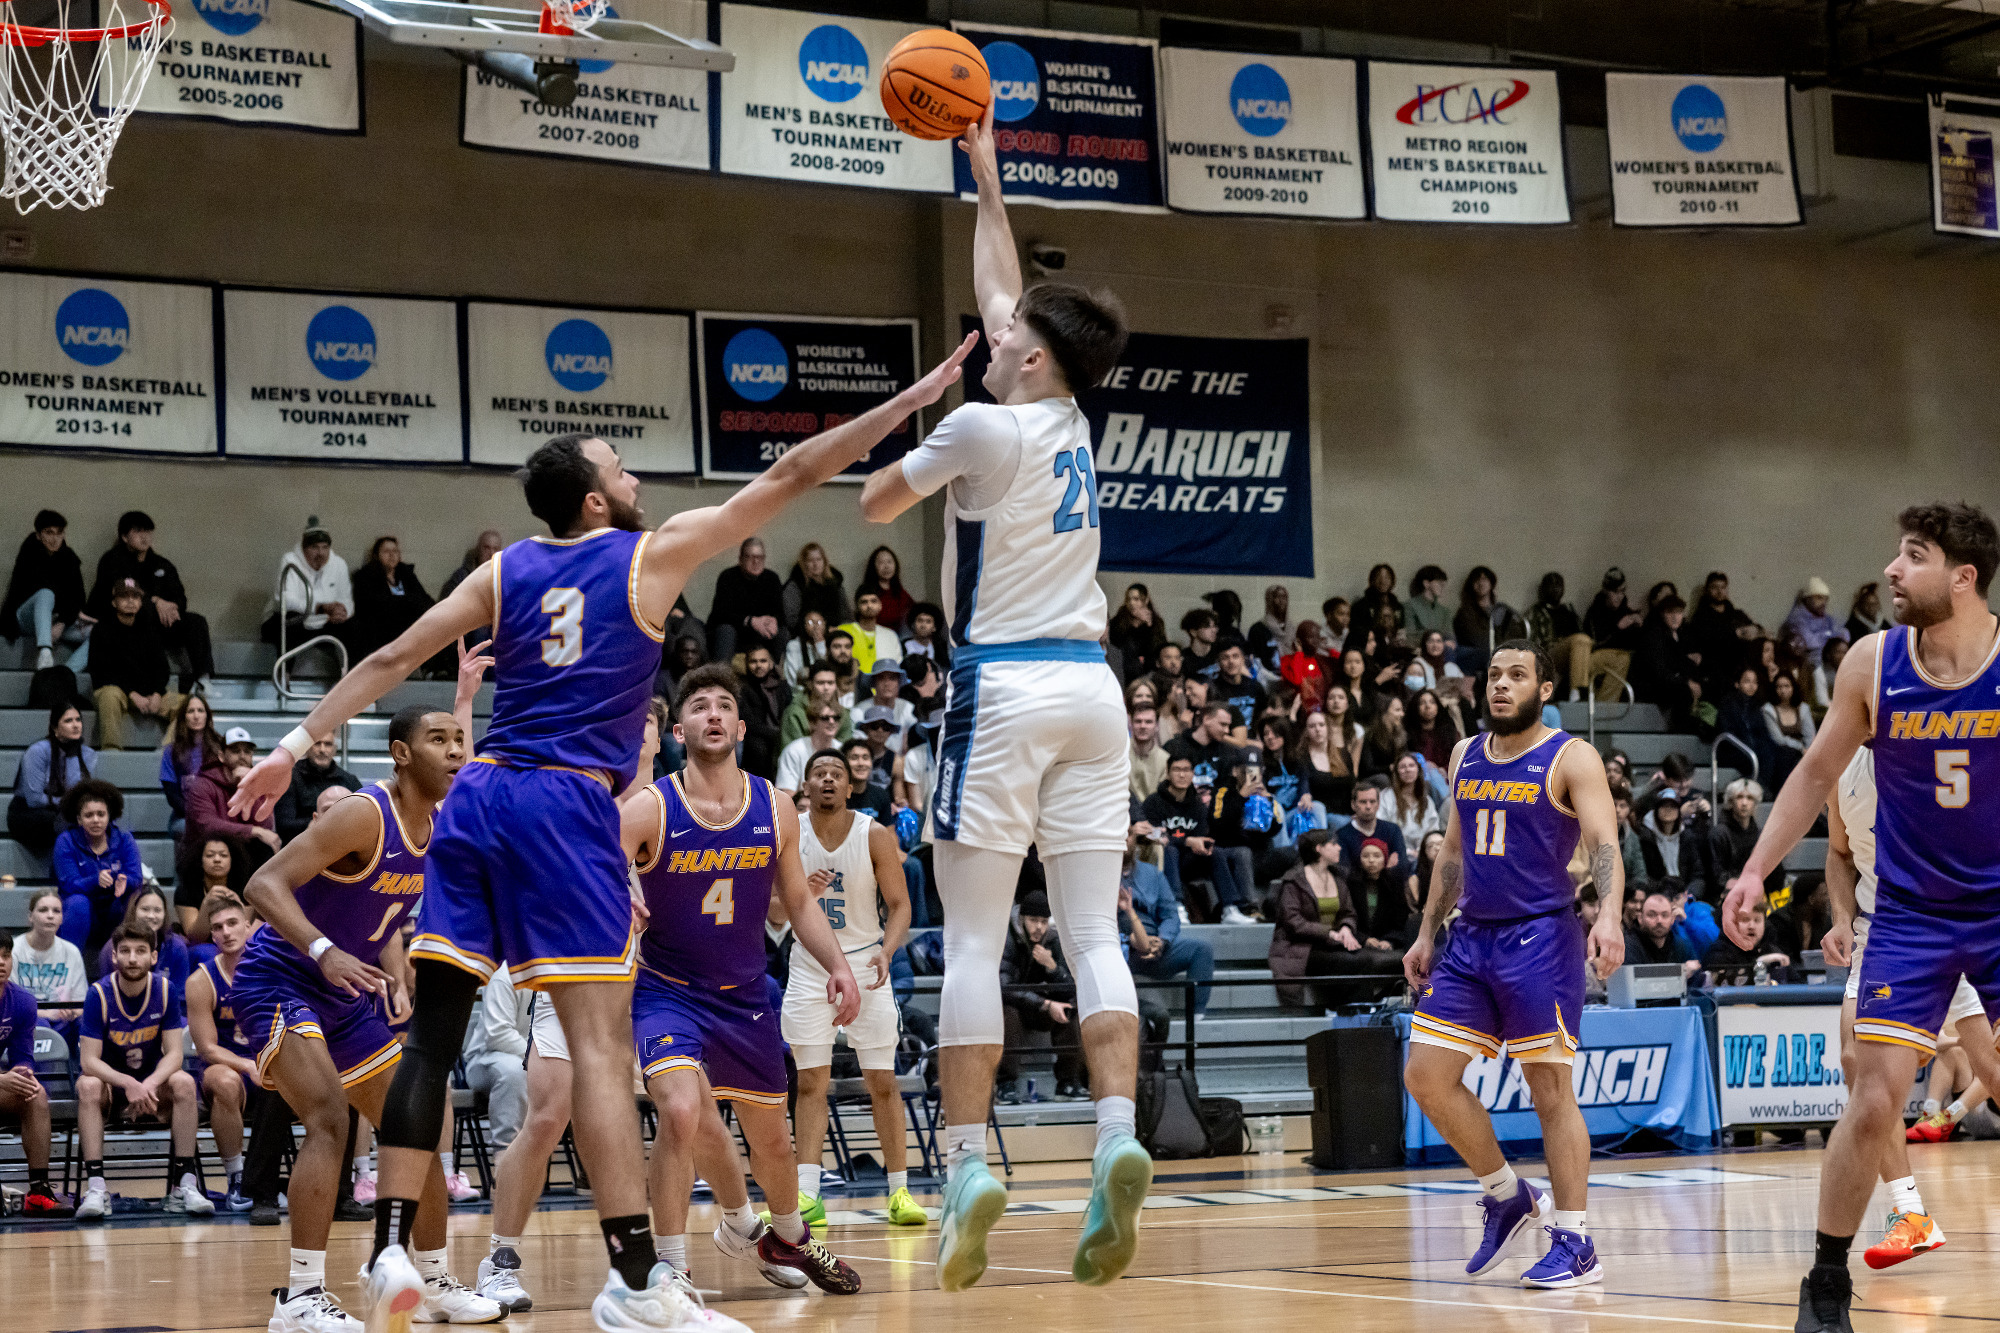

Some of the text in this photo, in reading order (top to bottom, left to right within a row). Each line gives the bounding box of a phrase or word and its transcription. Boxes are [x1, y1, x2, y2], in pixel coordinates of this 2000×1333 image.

[202, 42, 331, 68] BASKETBALL
[157, 61, 303, 88] TOURNAMENT
[806, 61, 867, 86] NCAA
[179, 87, 284, 110] 2005-2006
[577, 83, 700, 112] BASKETBALL
[908, 84, 973, 126] Wilson
[1047, 97, 1143, 118] TURNAMENT
[1237, 98, 1291, 120] NCAA
[1416, 83, 1512, 126] ECAC
[521, 99, 658, 128] TOURNAMENT
[745, 103, 801, 123] MEN'S
[810, 109, 902, 133] BASKETB
[539, 124, 639, 149] 2007-2008
[1678, 117, 1726, 136] NCAA
[772, 128, 903, 154] TOURNAMENT
[993, 128, 1149, 162] COND ROUND
[1166, 141, 1248, 159] WOMEN'S
[1405, 137, 1528, 154] METRO REGION
[790, 153, 885, 175] 2008-2009
[1002, 161, 1119, 190] 2008-2009
[1205, 165, 1323, 183] TOURNAMENT
[1388, 157, 1548, 175] MEN'S BASKETBALL
[1614, 160, 1690, 174] WOMEN'S
[1223, 187, 1309, 204] 2009-2010
[1420, 179, 1518, 195] CHAMPIONS
[1652, 180, 1759, 194] TOURNAMENT
[1451, 200, 1490, 214] 2010
[63, 325, 128, 347] NCAA
[314, 341, 376, 363] NCAA
[796, 344, 866, 359] WOMEN'S
[553, 354, 611, 374] NCAA
[730, 363, 788, 384] NCAA
[797, 361, 889, 377] BASKETBALL
[0, 370, 207, 397] OMEN'S BASKETBALL
[798, 379, 899, 393] TOURNAMENT
[1138, 367, 1183, 392] OF
[1190, 370, 1249, 396] THE
[25, 394, 164, 416] TOURNAMENT
[251, 386, 436, 408] MEN'S VOLLEYBALL
[492, 397, 670, 420] MEN'S BASKETBALL
[56, 418, 132, 436] 2013-14
[279, 408, 410, 428] TOURNAMENT
[518, 419, 645, 438] TOURNAMENT
[719, 410, 818, 433] SECOND
[323, 432, 367, 447] 2014
[1053, 446, 1098, 534] 21
[1097, 481, 1287, 513] BEARCATS
[541, 587, 585, 667] 3
[1527, 764, 1546, 773] CUNY
[1934, 749, 1970, 808] 5
[1456, 779, 1541, 804] HUNTER
[1475, 808, 1506, 856] 11
[667, 846, 772, 874] HUNTER
[370, 871, 424, 894] HUNT
[702, 878, 735, 925] 4
[1724, 1034, 1766, 1088] WE
[1462, 1040, 1669, 1110] BAUCH
